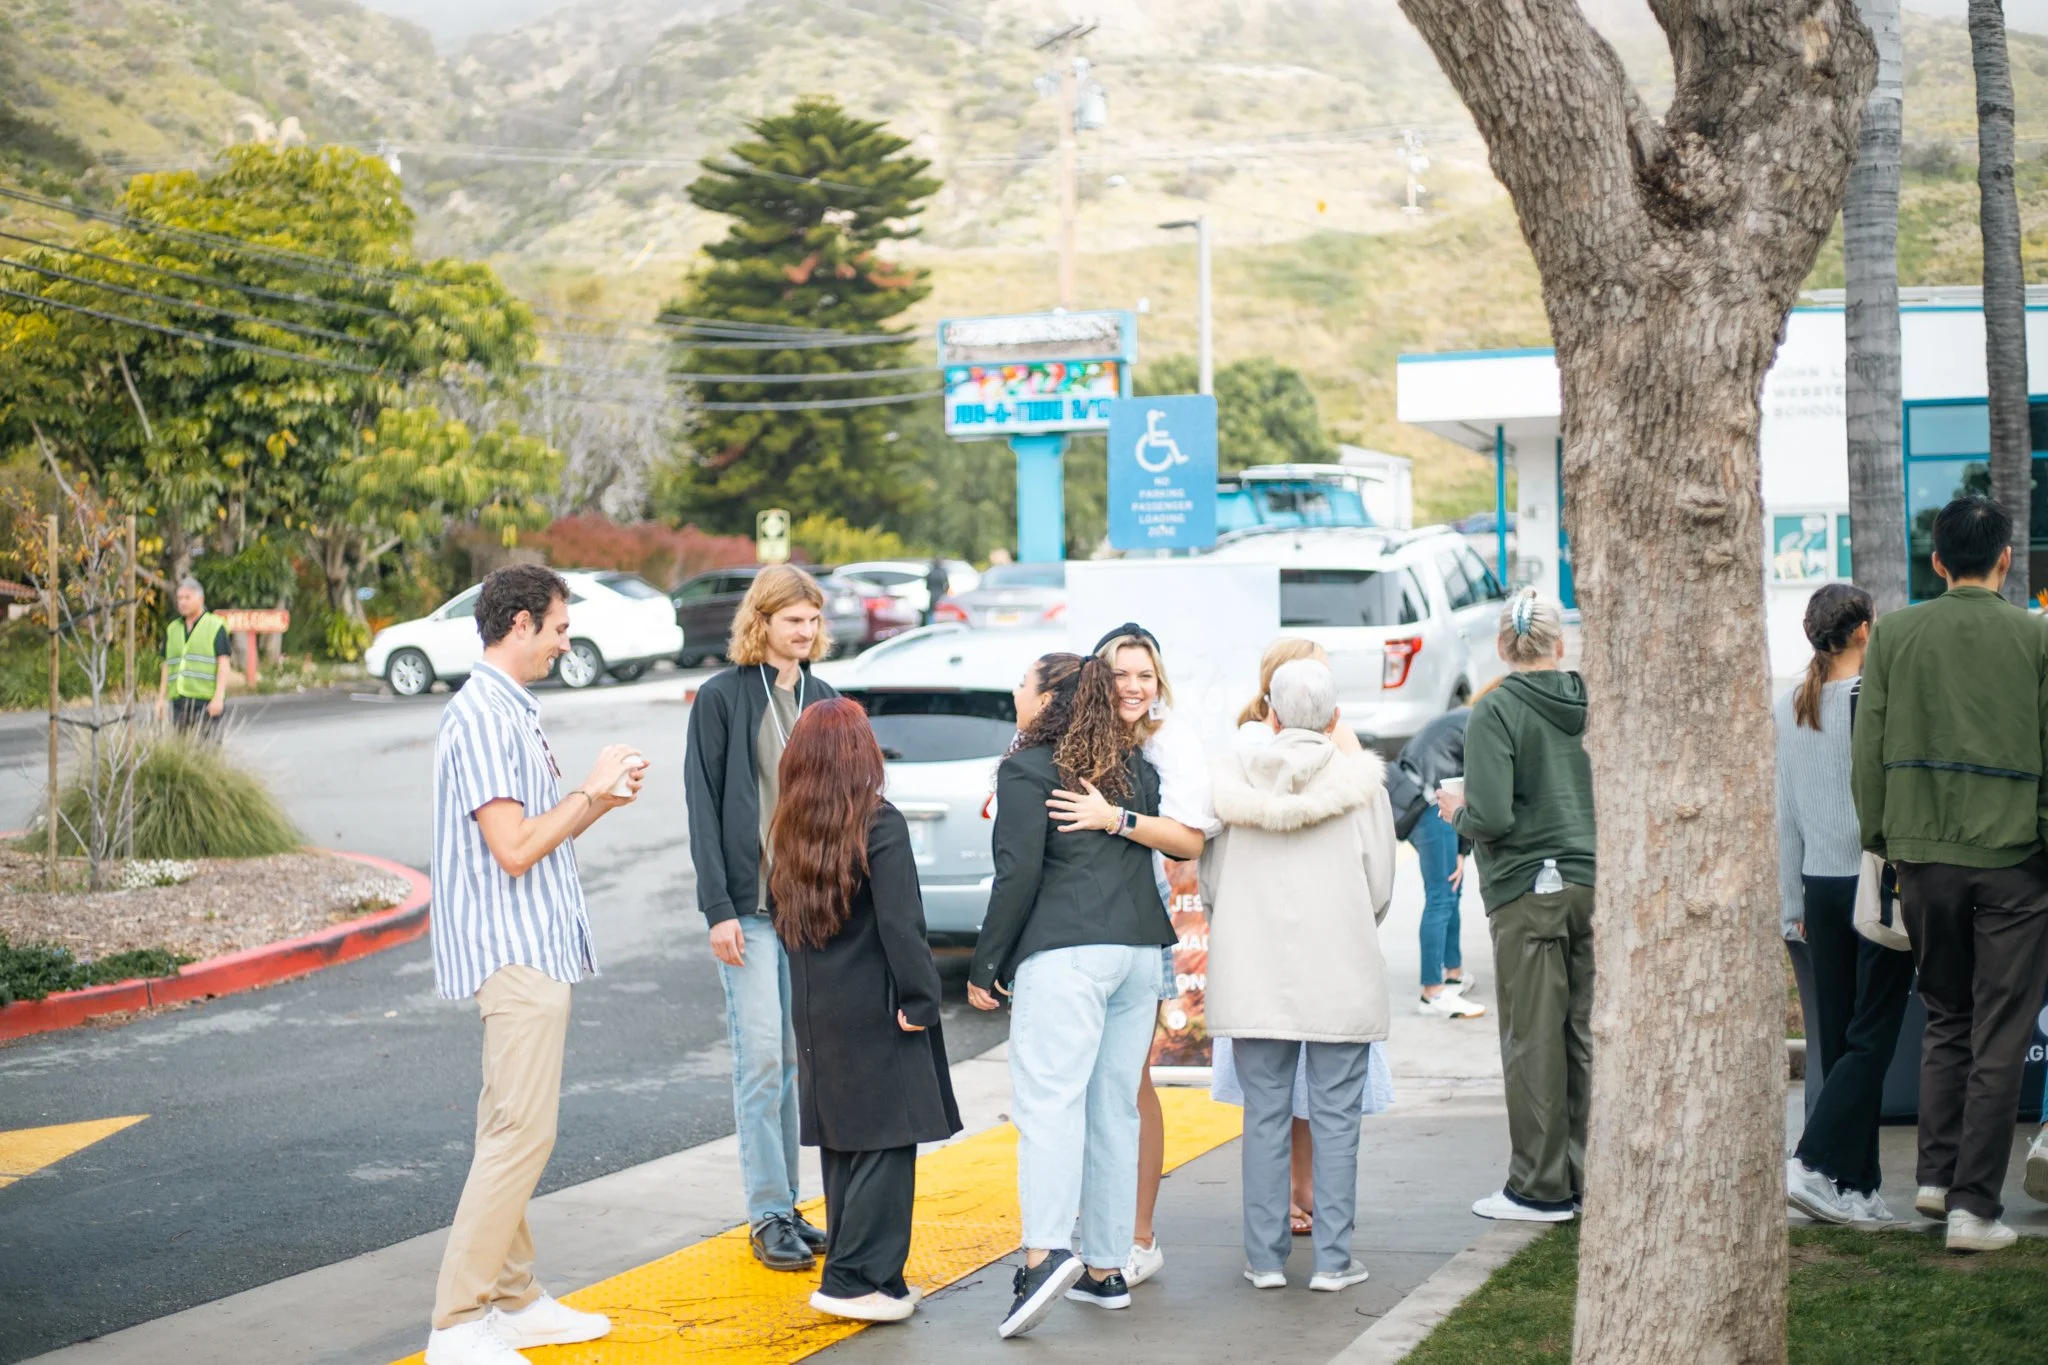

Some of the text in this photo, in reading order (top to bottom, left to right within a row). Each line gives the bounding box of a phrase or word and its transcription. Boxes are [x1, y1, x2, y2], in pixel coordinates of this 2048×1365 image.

[1773, 384, 1843, 398] WEBSTE
[1153, 475, 1171, 487] NO
[1138, 488, 1186, 499] PARKING
[1131, 499, 1194, 512] PASSENGER
[1138, 513, 1186, 525] LOADING
[1171, 894, 1204, 912] JES
